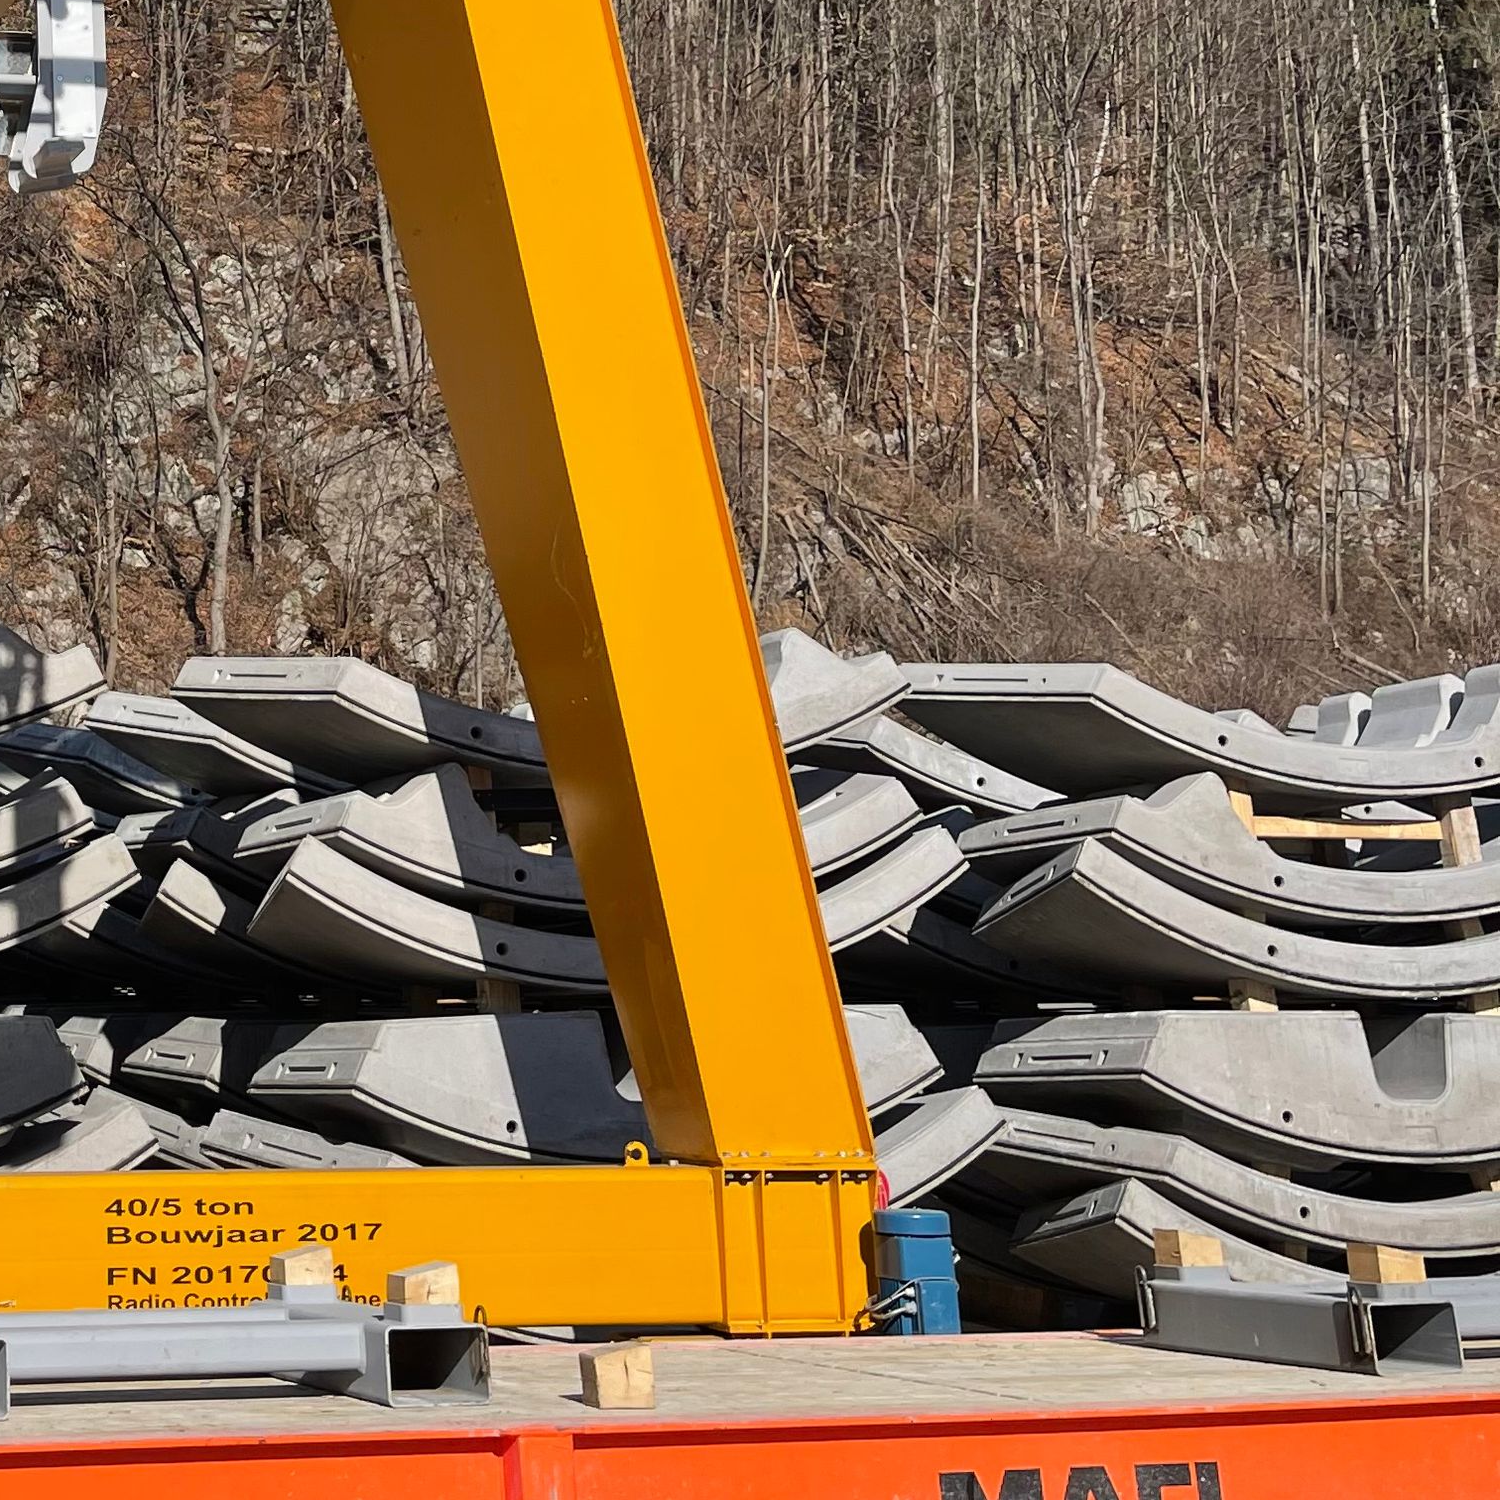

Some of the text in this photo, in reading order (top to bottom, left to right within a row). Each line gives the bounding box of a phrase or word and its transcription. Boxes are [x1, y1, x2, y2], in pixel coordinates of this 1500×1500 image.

[104, 1198, 254, 1217] 40/5 ton
[107, 1223, 382, 1248] Bouwjaar 2017
[107, 1264, 348, 1285] FN 20174
[108, 1294, 176, 1309] Radio
